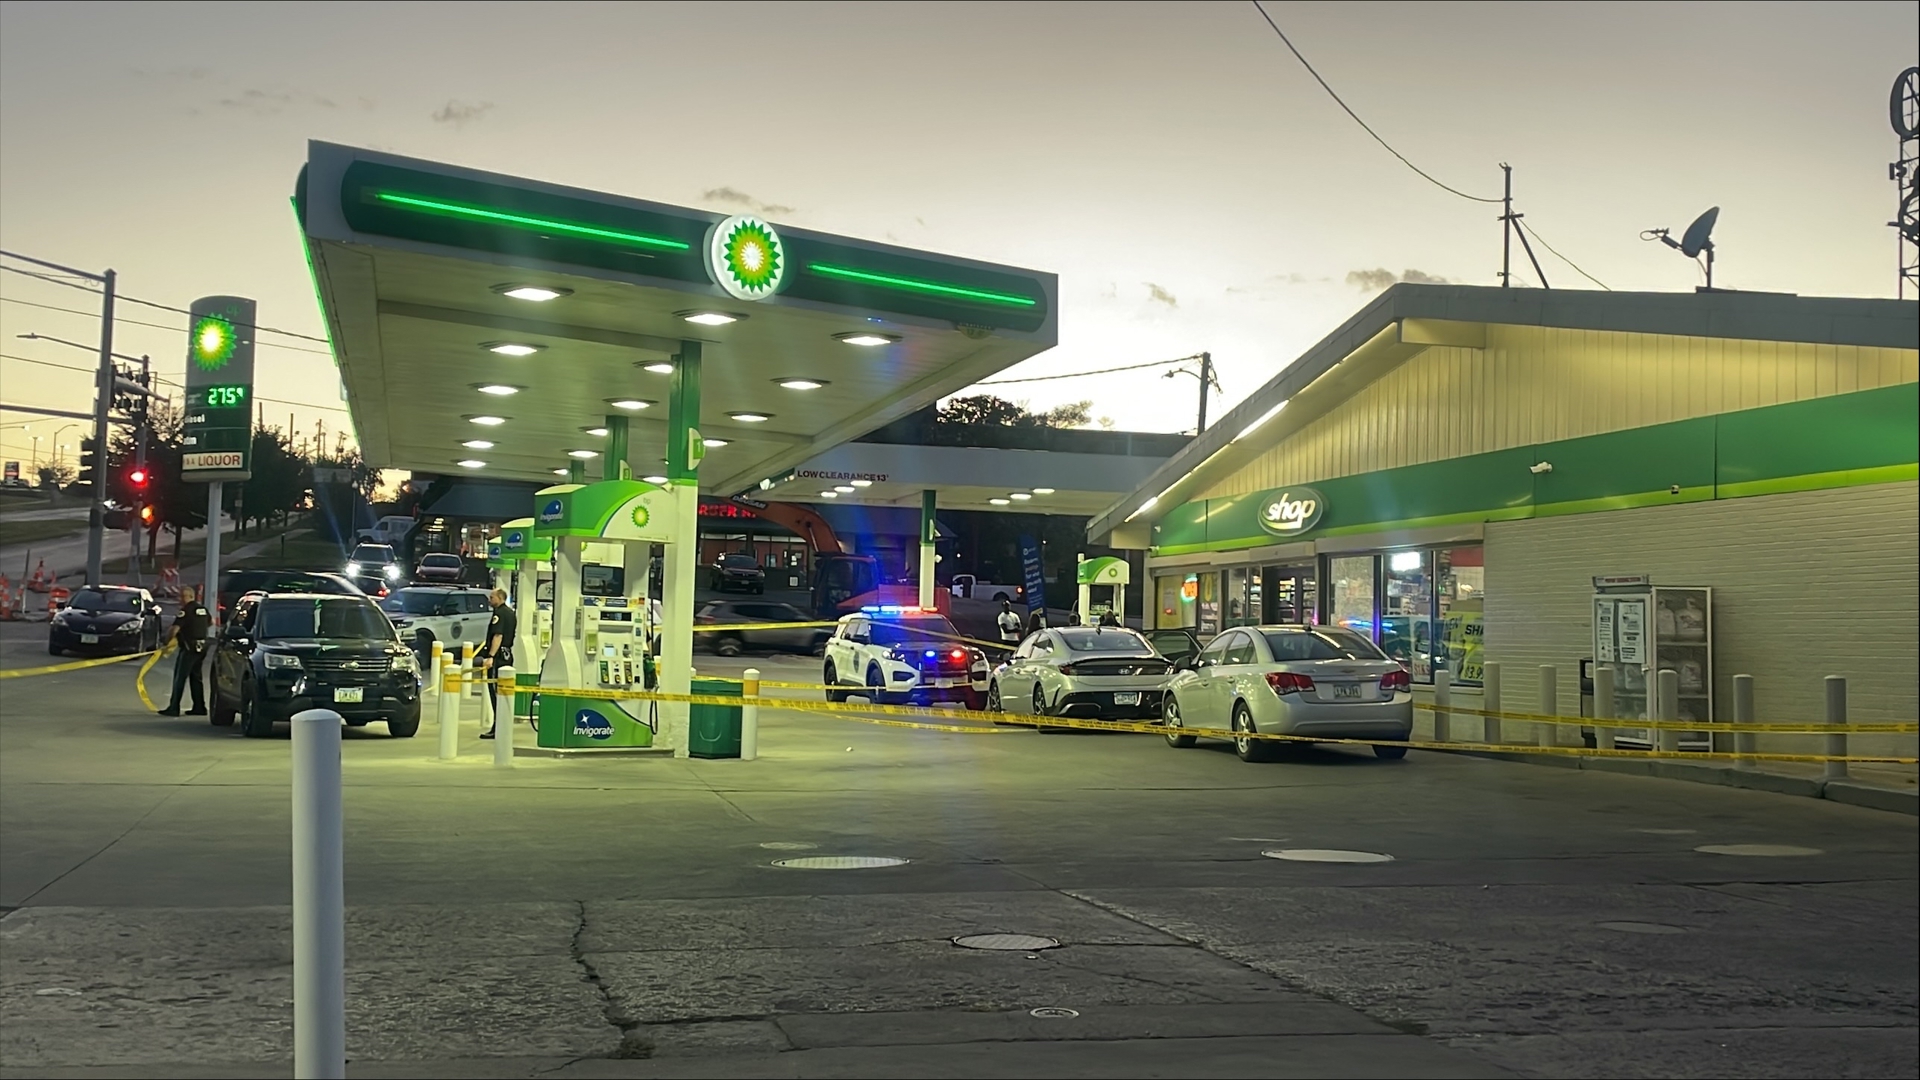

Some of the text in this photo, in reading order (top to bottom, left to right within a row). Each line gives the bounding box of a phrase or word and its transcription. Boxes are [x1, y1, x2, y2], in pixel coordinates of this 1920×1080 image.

[198, 454, 241, 467] LIQUOR
[797, 470, 818, 478] LOW
[819, 471, 876, 482] CLEARANCE
[1268, 492, 1316, 529] shop
[573, 726, 615, 738] Invigorate
